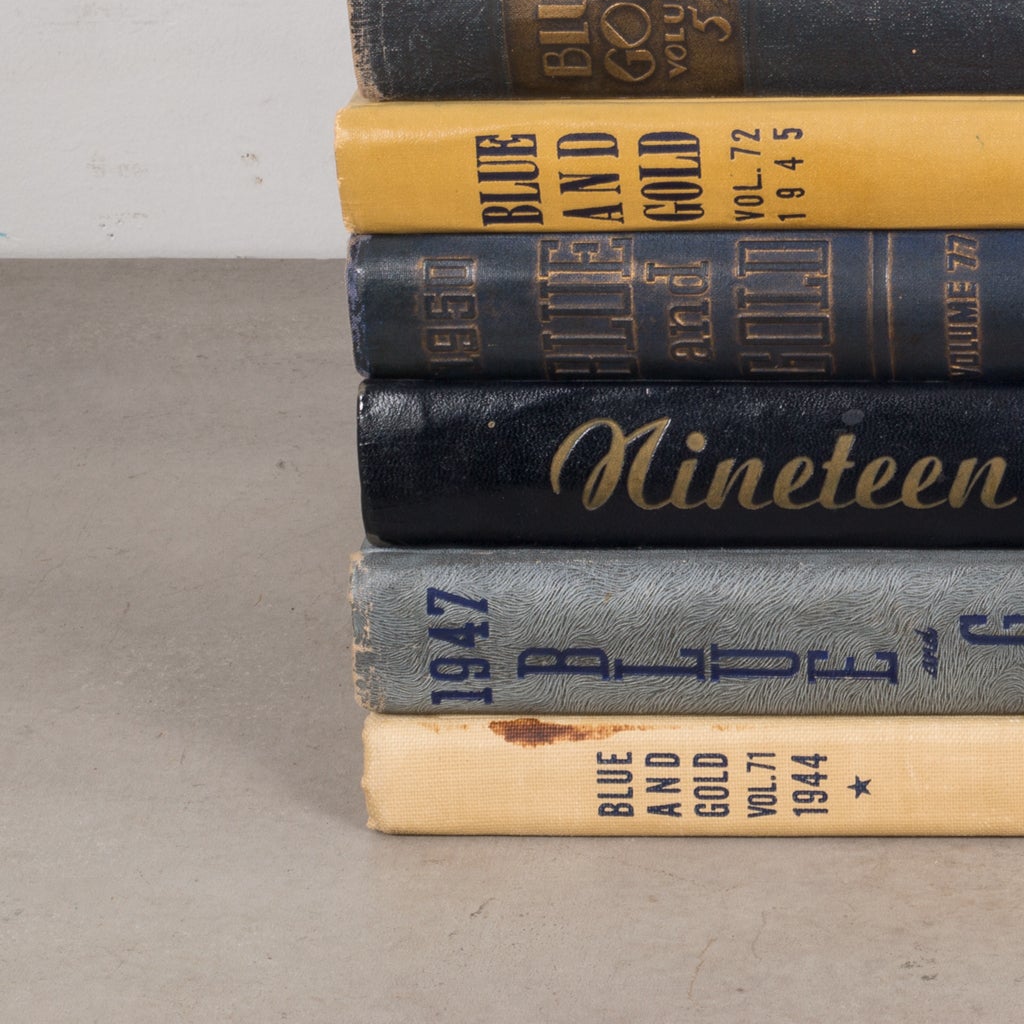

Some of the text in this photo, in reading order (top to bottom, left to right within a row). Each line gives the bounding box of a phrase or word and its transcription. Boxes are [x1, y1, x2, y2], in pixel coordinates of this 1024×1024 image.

[475, 132, 544, 227] BLUE
[557, 130, 626, 226] AND
[638, 130, 707, 226] GOLD
[773, 127, 807, 222] 1945
[421, 255, 480, 371] 1950
[537, 236, 639, 378] BLUE
[645, 260, 713, 362] and
[735, 237, 833, 377] GOLD
[944, 234, 981, 377] VOLUME 77
[550, 415, 1018, 512] Nineteen
[425, 586, 494, 707] 1947
[516, 643, 899, 685] BLUE
[596, 750, 635, 818] BLUE
[645, 751, 682, 818] AND
[692, 752, 730, 818] GOLD
[790, 752, 829, 818] 1944
